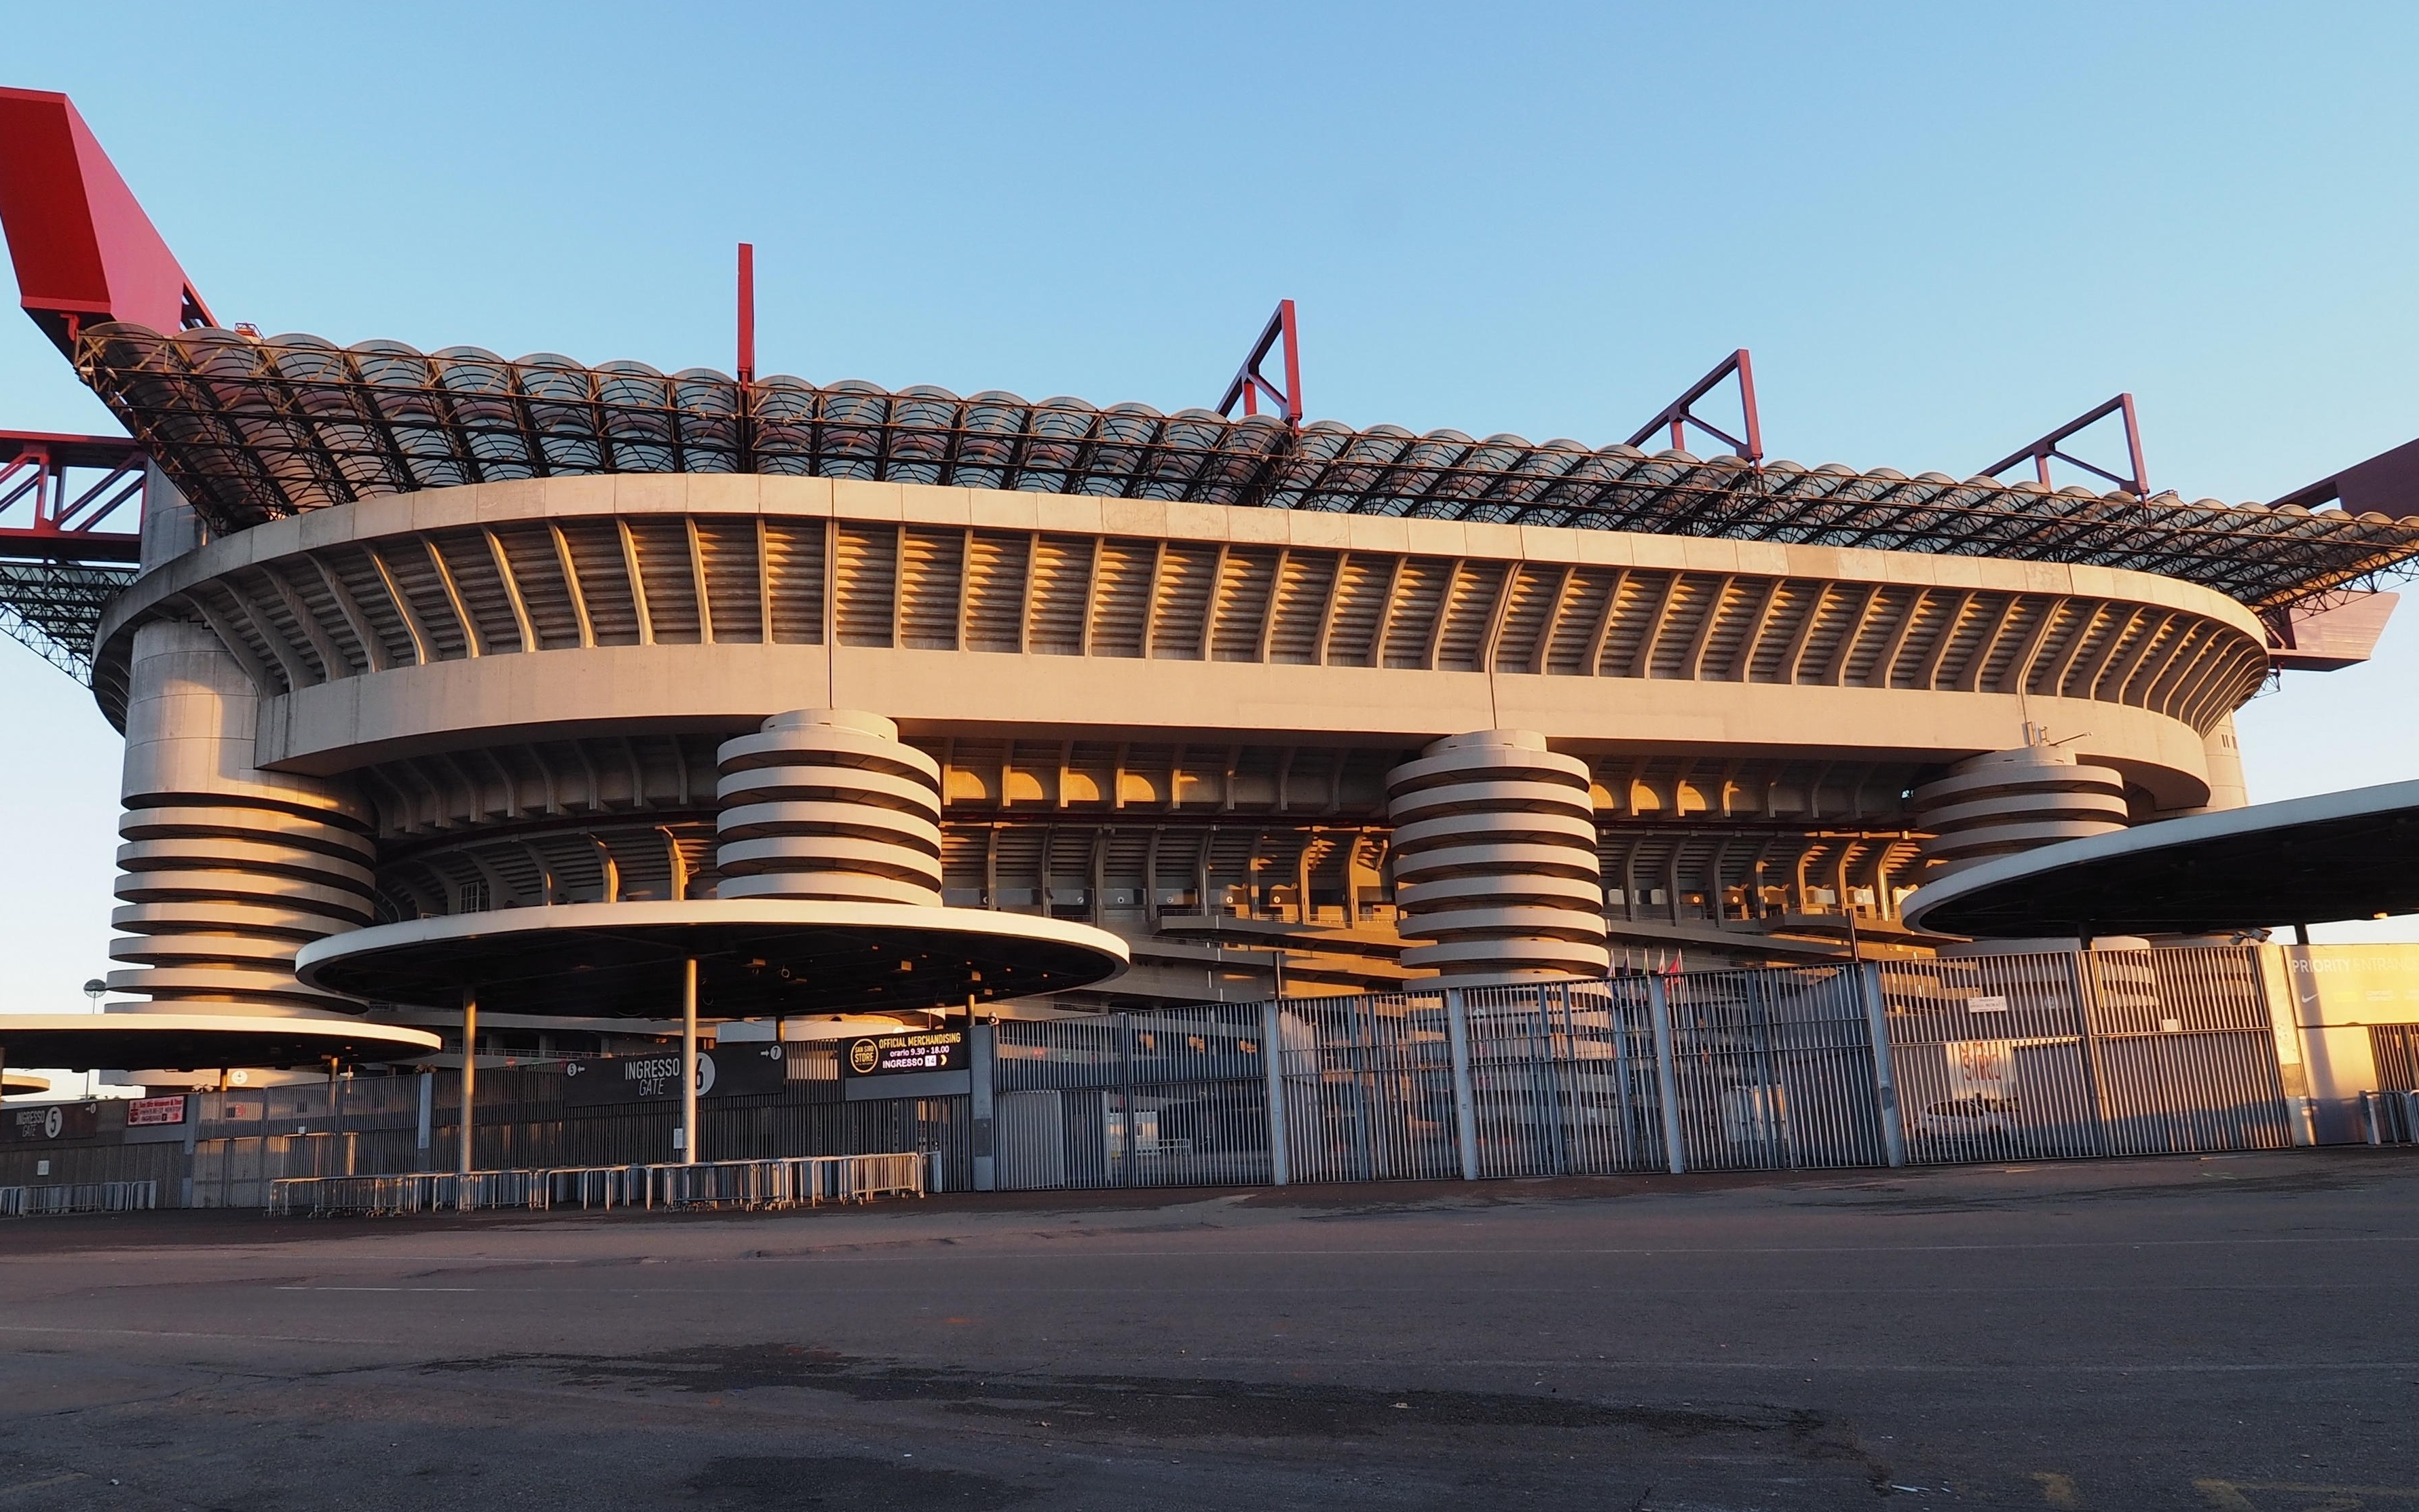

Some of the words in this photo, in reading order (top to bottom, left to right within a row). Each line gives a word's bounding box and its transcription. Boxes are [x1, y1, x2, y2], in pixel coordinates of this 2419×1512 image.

[2292, 958, 2350, 973] PRIORITY
[878, 1037, 907, 1049] OFFICIAL
[907, 1032, 961, 1047] MERCHANDISING
[855, 1053, 874, 1063] STORE
[890, 1048, 910, 1057] orario
[910, 1047, 925, 1056] 9.30
[624, 1057, 679, 1080] INGRESSO
[882, 1057, 924, 1069] INGRESSO
[639, 1078, 665, 1097] GATE
[16, 1110, 45, 1125] INGRESSO
